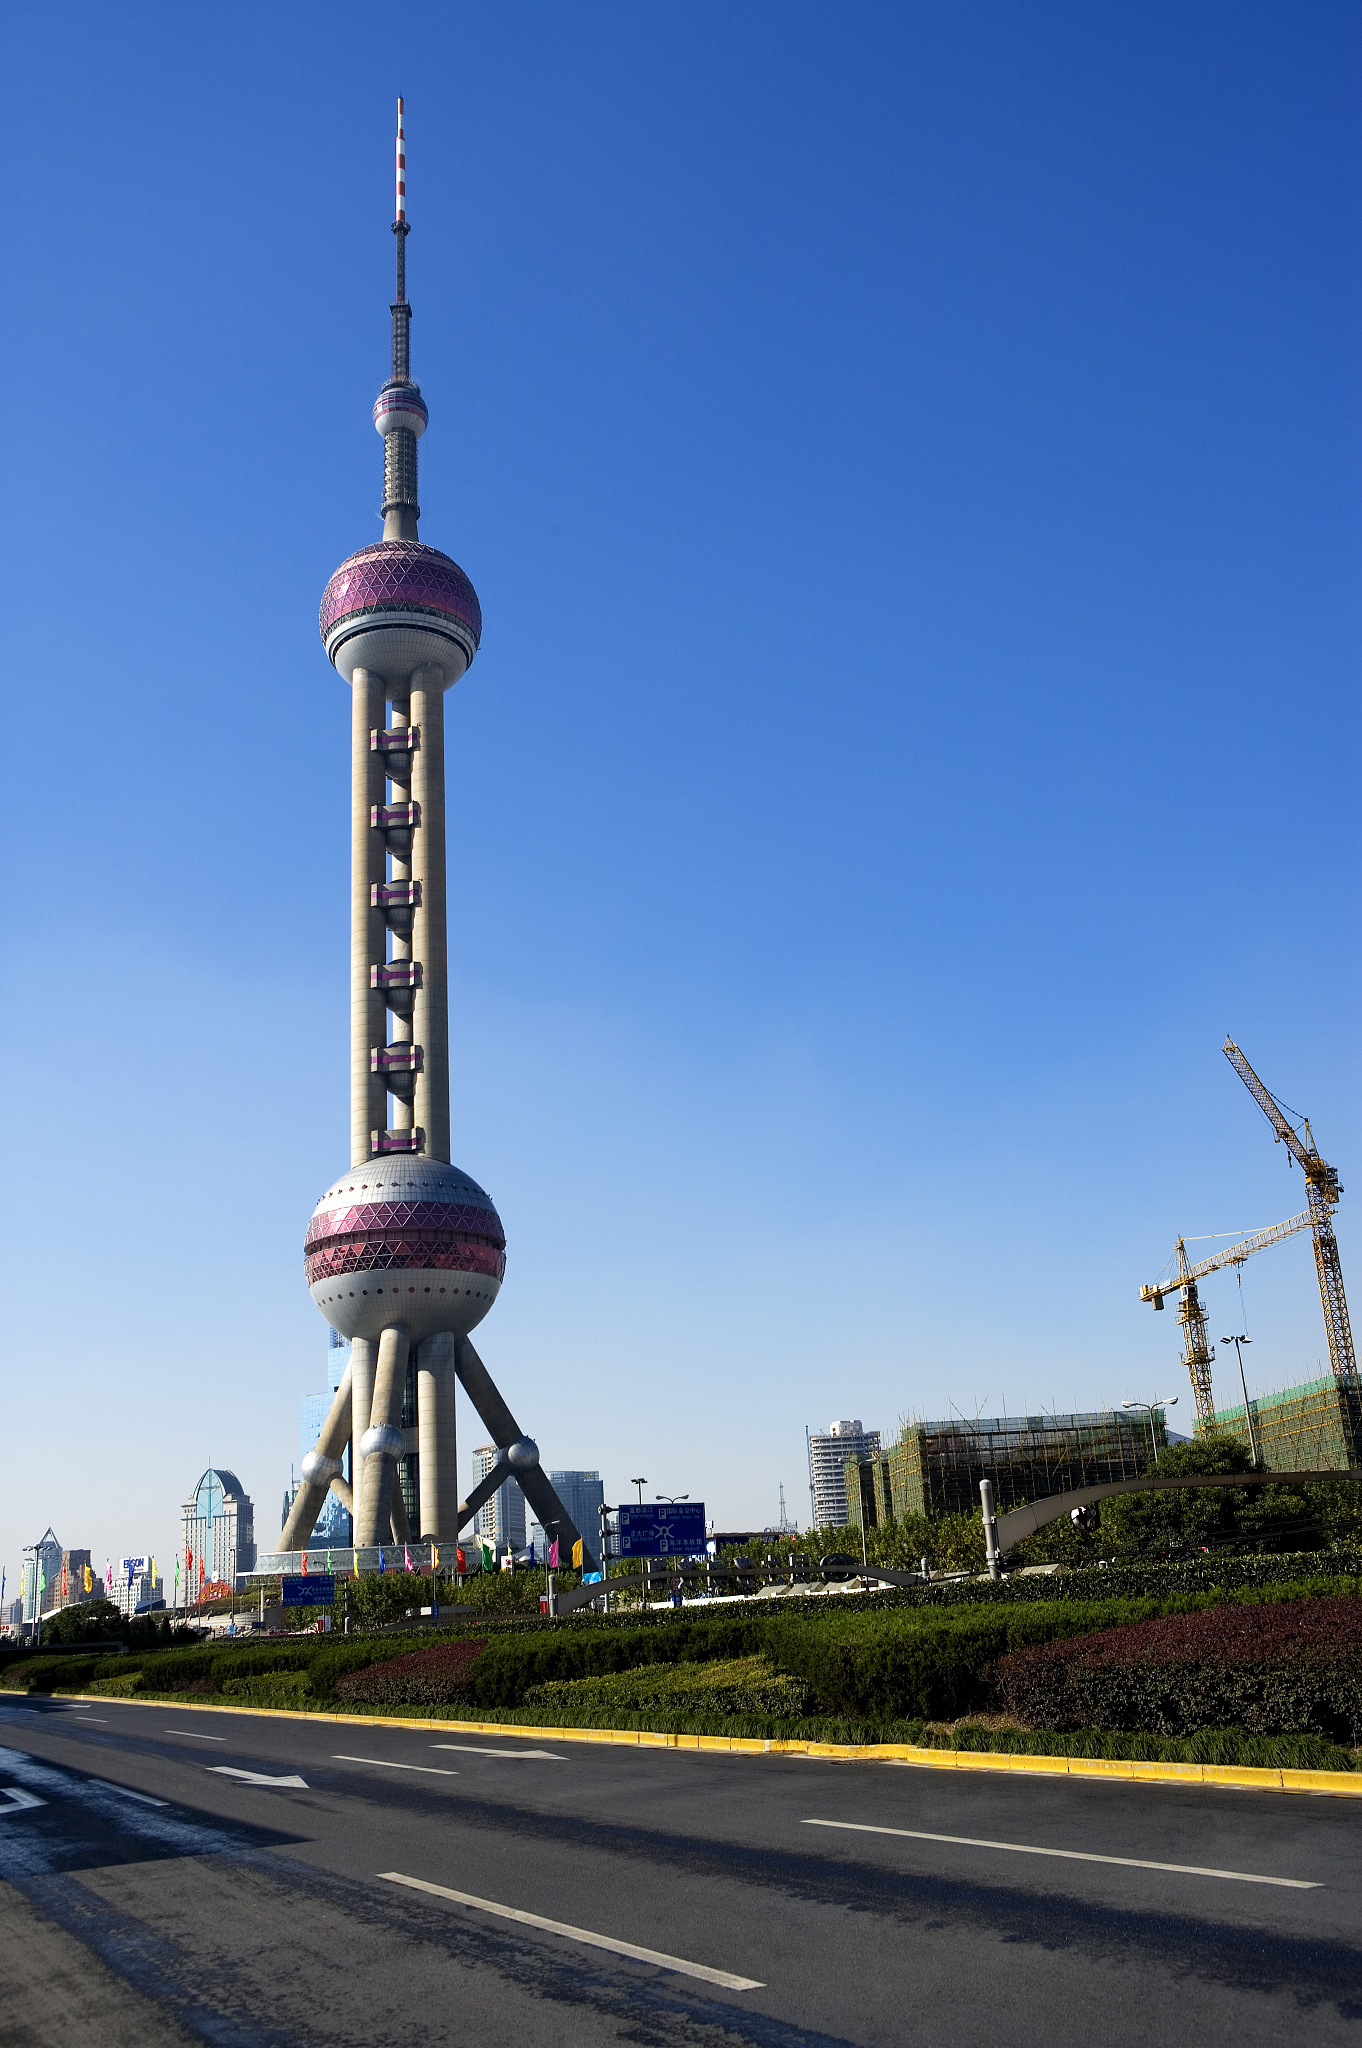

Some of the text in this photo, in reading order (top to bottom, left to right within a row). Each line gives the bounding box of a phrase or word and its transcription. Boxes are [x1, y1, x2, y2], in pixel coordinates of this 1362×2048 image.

[666, 1507, 702, 1515] 国际会议中心
[669, 1538, 702, 1546] 海洋水族馆
[123, 1558, 144, 1569] ESON
